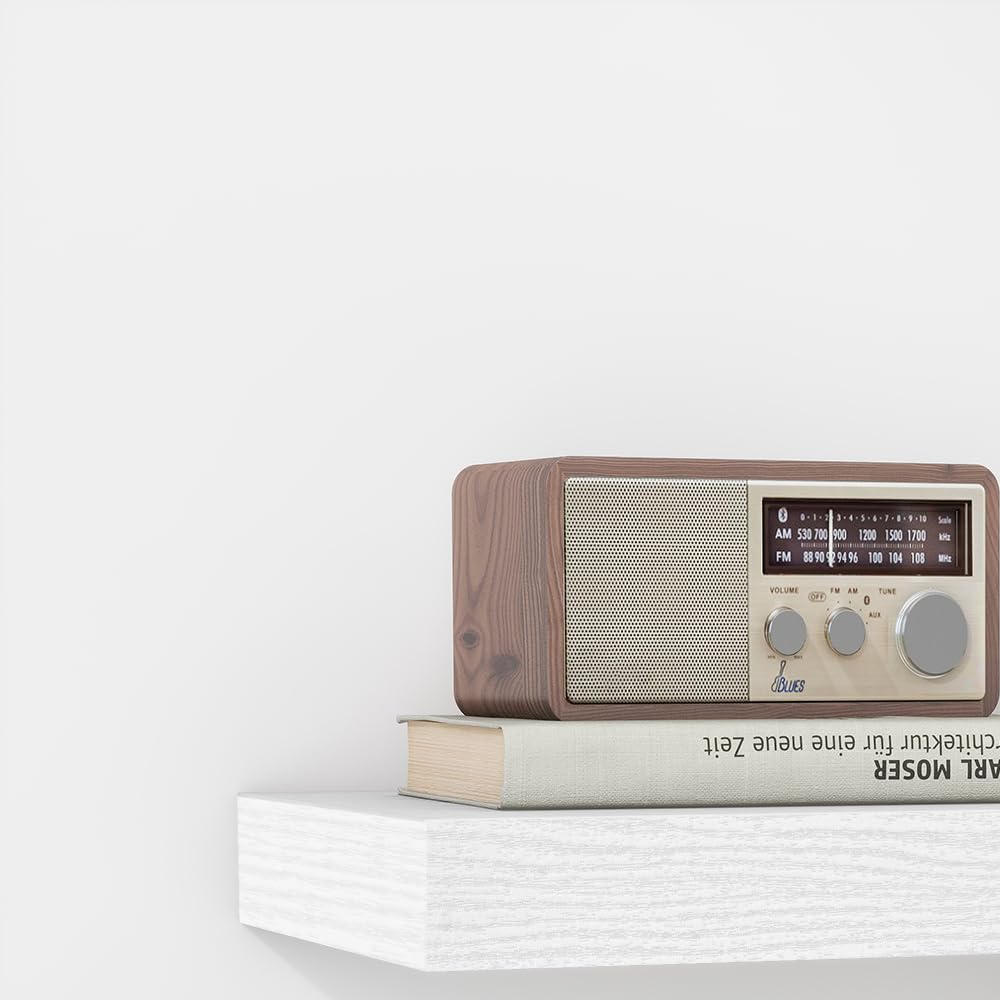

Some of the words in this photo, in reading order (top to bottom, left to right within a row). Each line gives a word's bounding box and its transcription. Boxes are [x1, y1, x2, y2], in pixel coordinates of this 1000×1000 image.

[920, 514, 927, 522] 10
[775, 528, 792, 539] AM
[797, 528, 812, 540] 530
[814, 528, 828, 540] 700
[832, 528, 847, 540] 900
[859, 529, 877, 541] 1200
[885, 529, 903, 541] 1500
[908, 529, 926, 542] 1700
[776, 551, 791, 562] FM
[803, 551, 813, 564] 88
[814, 551, 825, 564] 90
[837, 551, 847, 564] 94
[848, 551, 858, 564] 96
[868, 551, 883, 564] 100
[889, 551, 903, 564] 104
[911, 551, 925, 564] 108
[778, 676, 806, 692] BLUES
[703, 737, 745, 758] Zeit
[753, 736, 803, 751] neue
[812, 735, 856, 756] eine
[864, 735, 893, 756] für
[874, 759, 950, 780] MOSER
